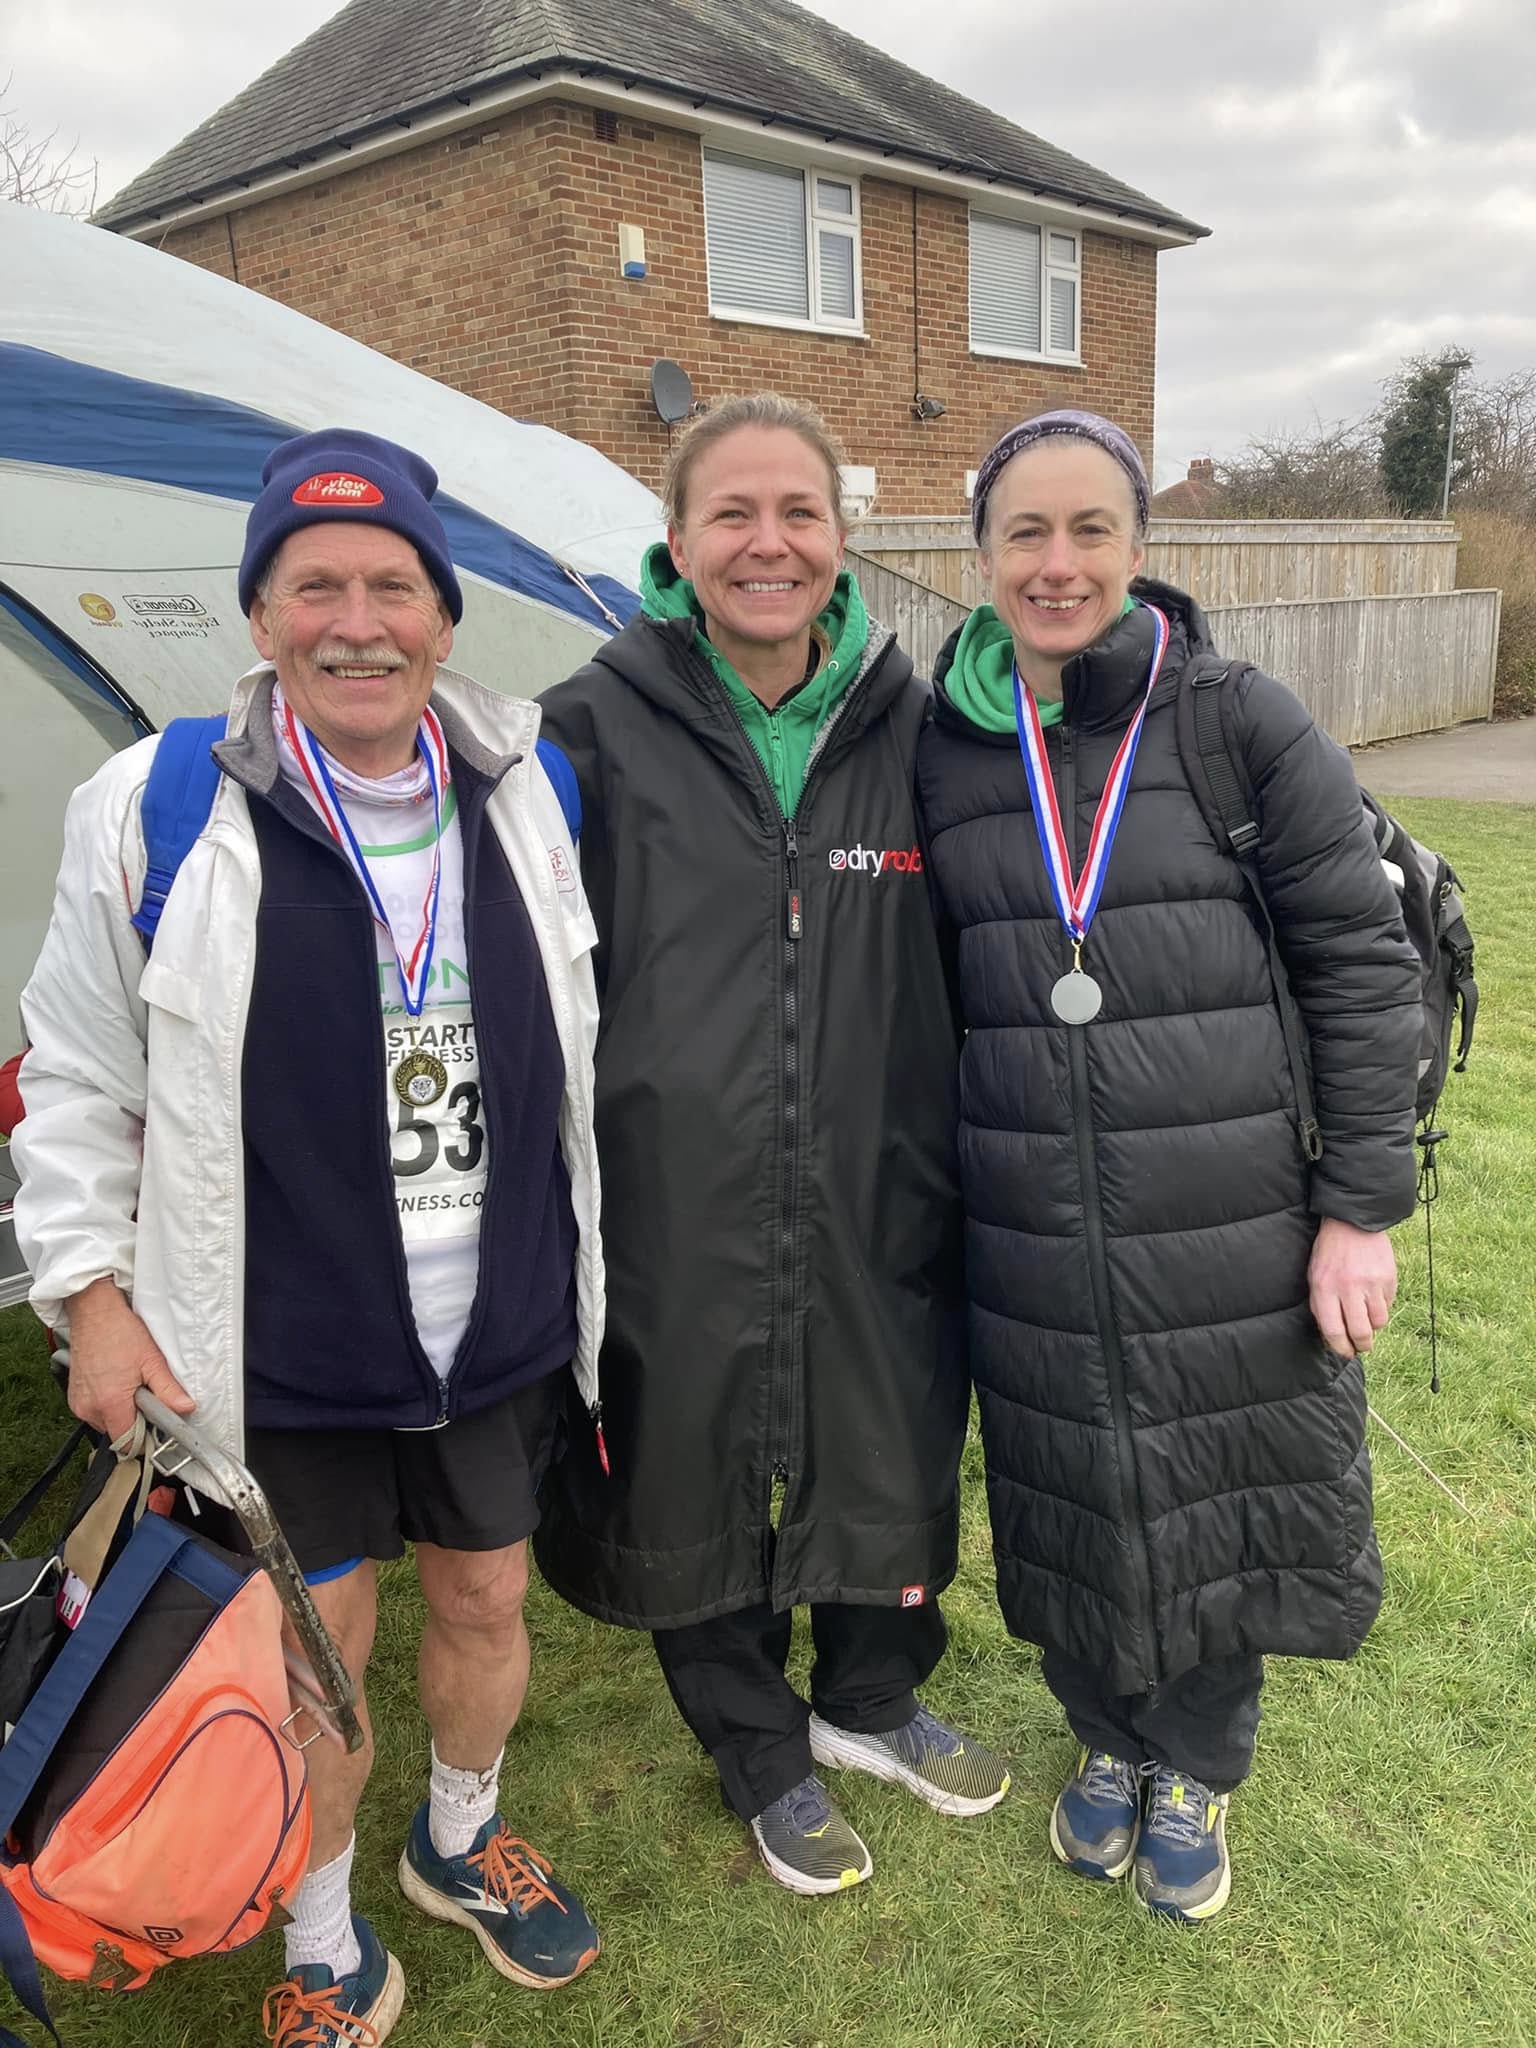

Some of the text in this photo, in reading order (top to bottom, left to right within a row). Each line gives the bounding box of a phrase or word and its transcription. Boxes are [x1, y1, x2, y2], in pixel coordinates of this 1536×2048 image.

[321, 486, 362, 498] from
[329, 477, 368, 491] view
[387, 1022, 474, 1048] START
[392, 1080, 485, 1177] 53
[395, 1191, 484, 1213] NESS.CO
